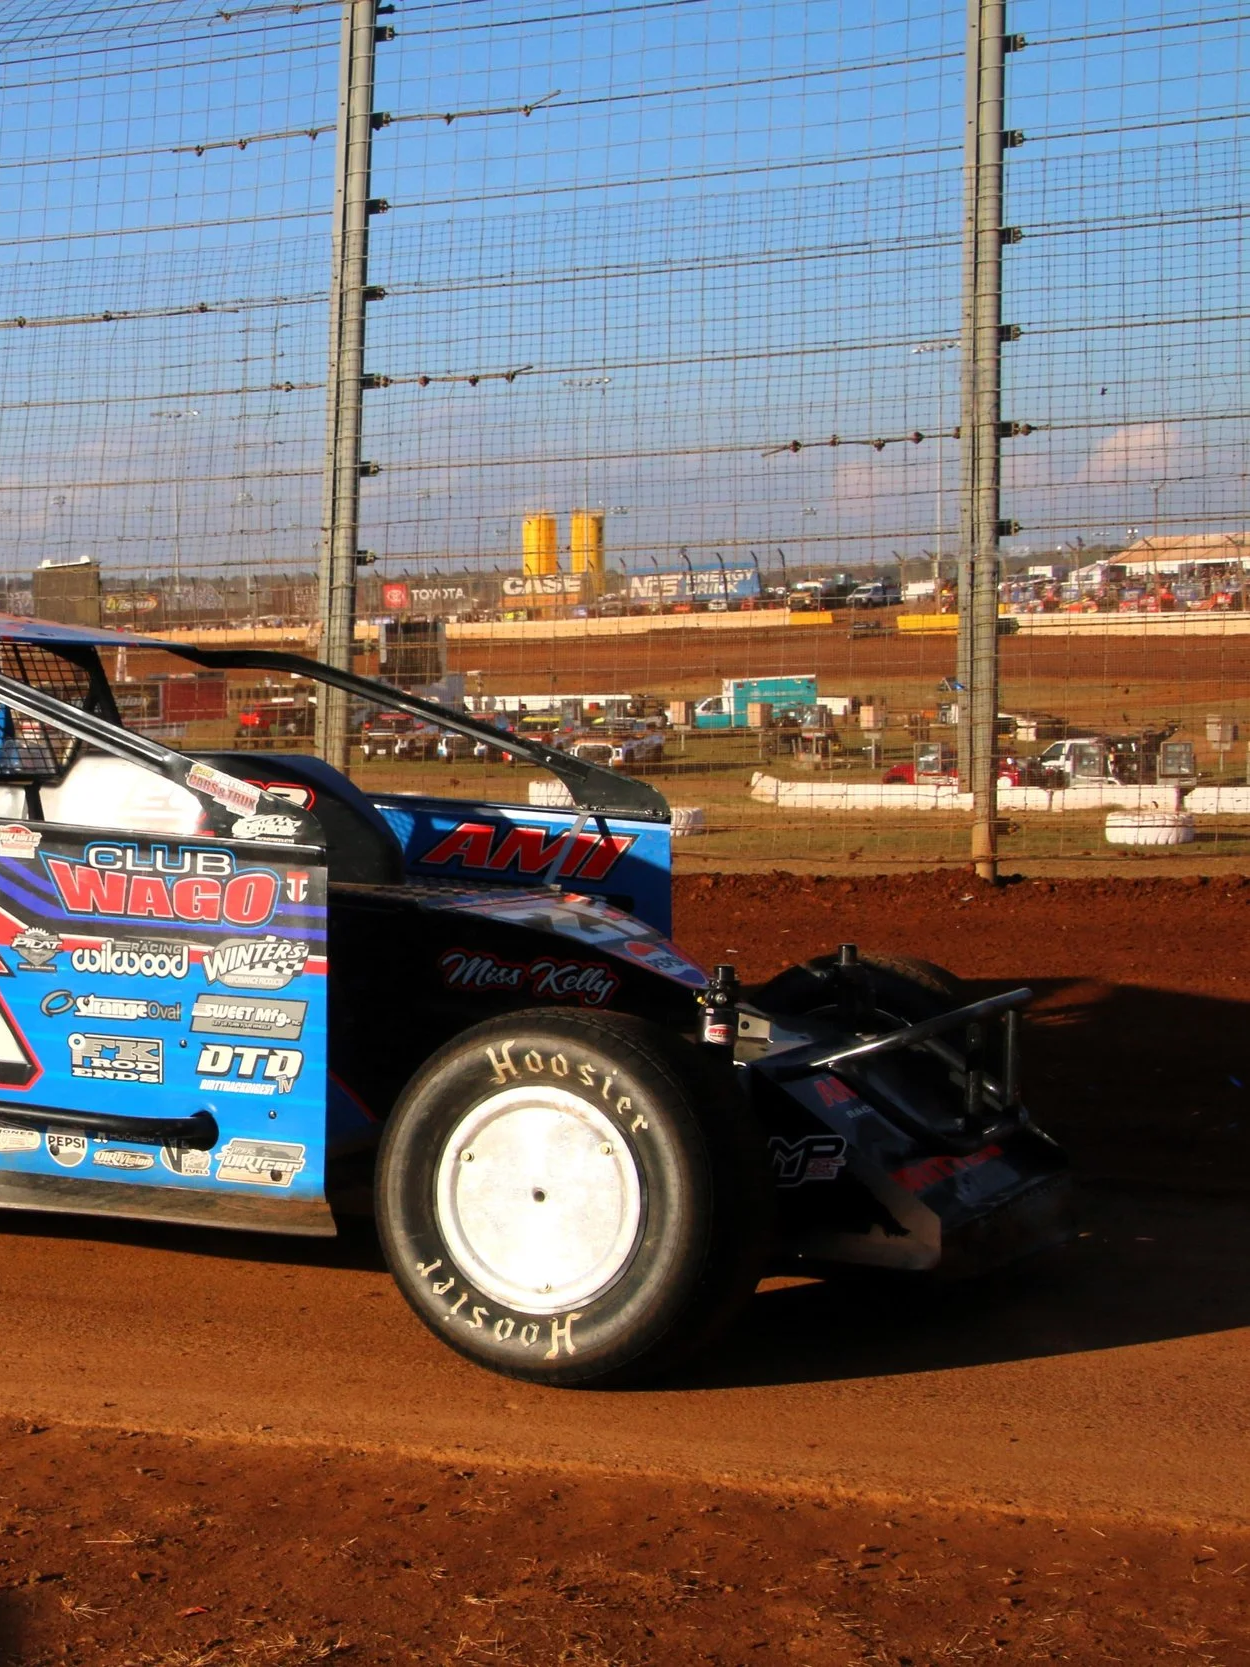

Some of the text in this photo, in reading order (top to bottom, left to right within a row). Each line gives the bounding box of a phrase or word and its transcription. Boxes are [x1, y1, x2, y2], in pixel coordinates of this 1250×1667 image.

[502, 577, 581, 596] CASE
[686, 569, 754, 583] ENERGY
[411, 588, 466, 600] TOYOTA
[686, 582, 738, 595] DRINK
[88, 846, 235, 877] CLUB
[48, 858, 279, 925] WAGO
[71, 940, 190, 979] wilwood
[131, 943, 182, 955] RACING
[202, 941, 304, 982] WINTERS
[442, 953, 616, 1005] Miss Kelly
[192, 1002, 255, 1021] SWEET
[84, 1037, 160, 1063] FK
[197, 1043, 303, 1079] DTD
[72, 1067, 160, 1083] ENDS
[91, 1057, 160, 1072] ROD
[486, 1040, 649, 1134] Hoosier
[48, 1135, 85, 1149] PEPSI
[415, 1258, 584, 1360] Hoosier
